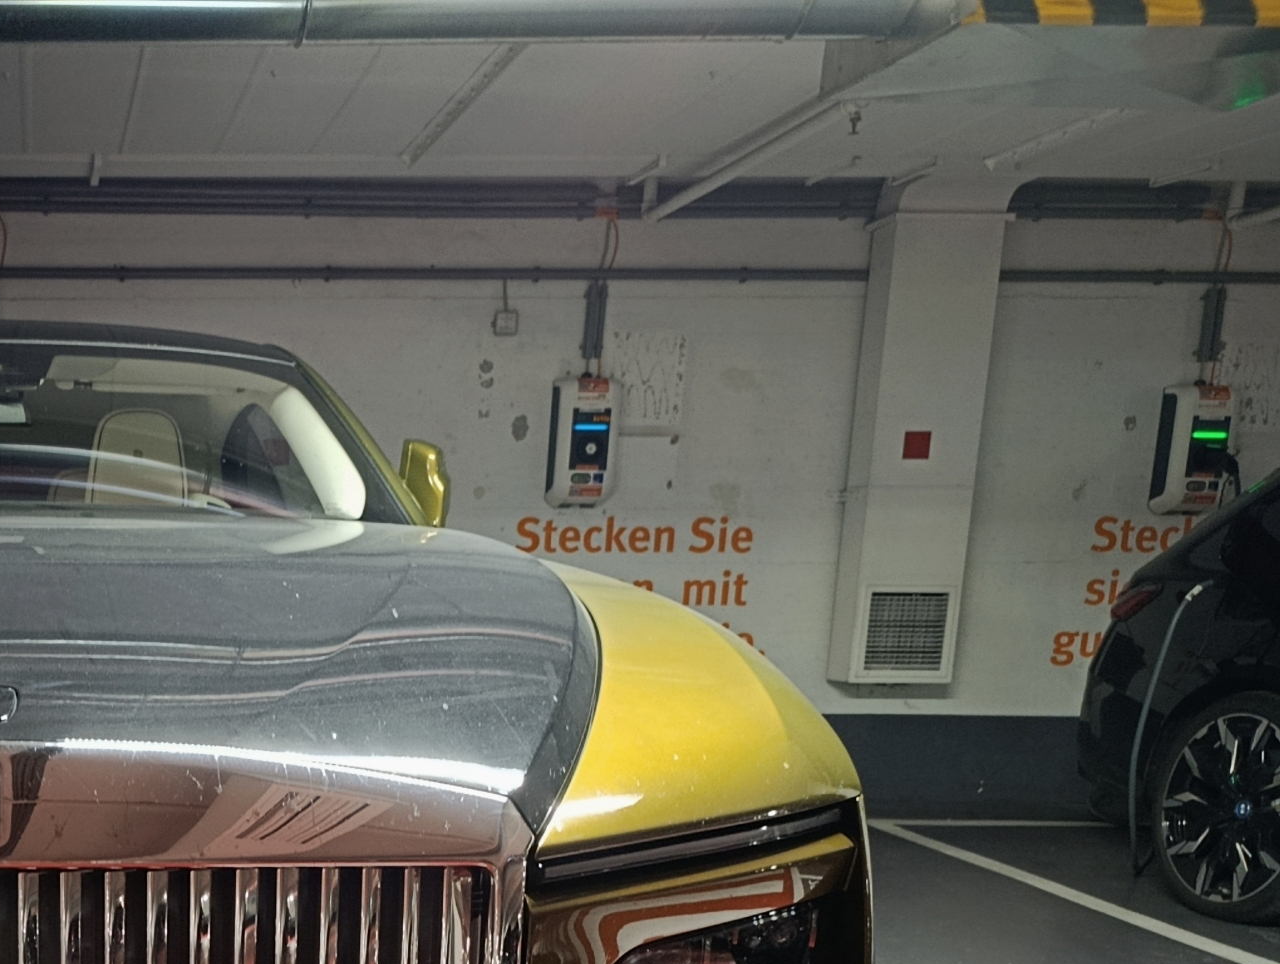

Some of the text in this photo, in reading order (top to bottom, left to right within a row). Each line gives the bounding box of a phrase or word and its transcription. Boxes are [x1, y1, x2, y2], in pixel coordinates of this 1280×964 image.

[516, 516, 754, 553] Stecken Sie
[682, 569, 748, 606] mit
[1084, 569, 1129, 606] si
[1050, 631, 1103, 667] gu
